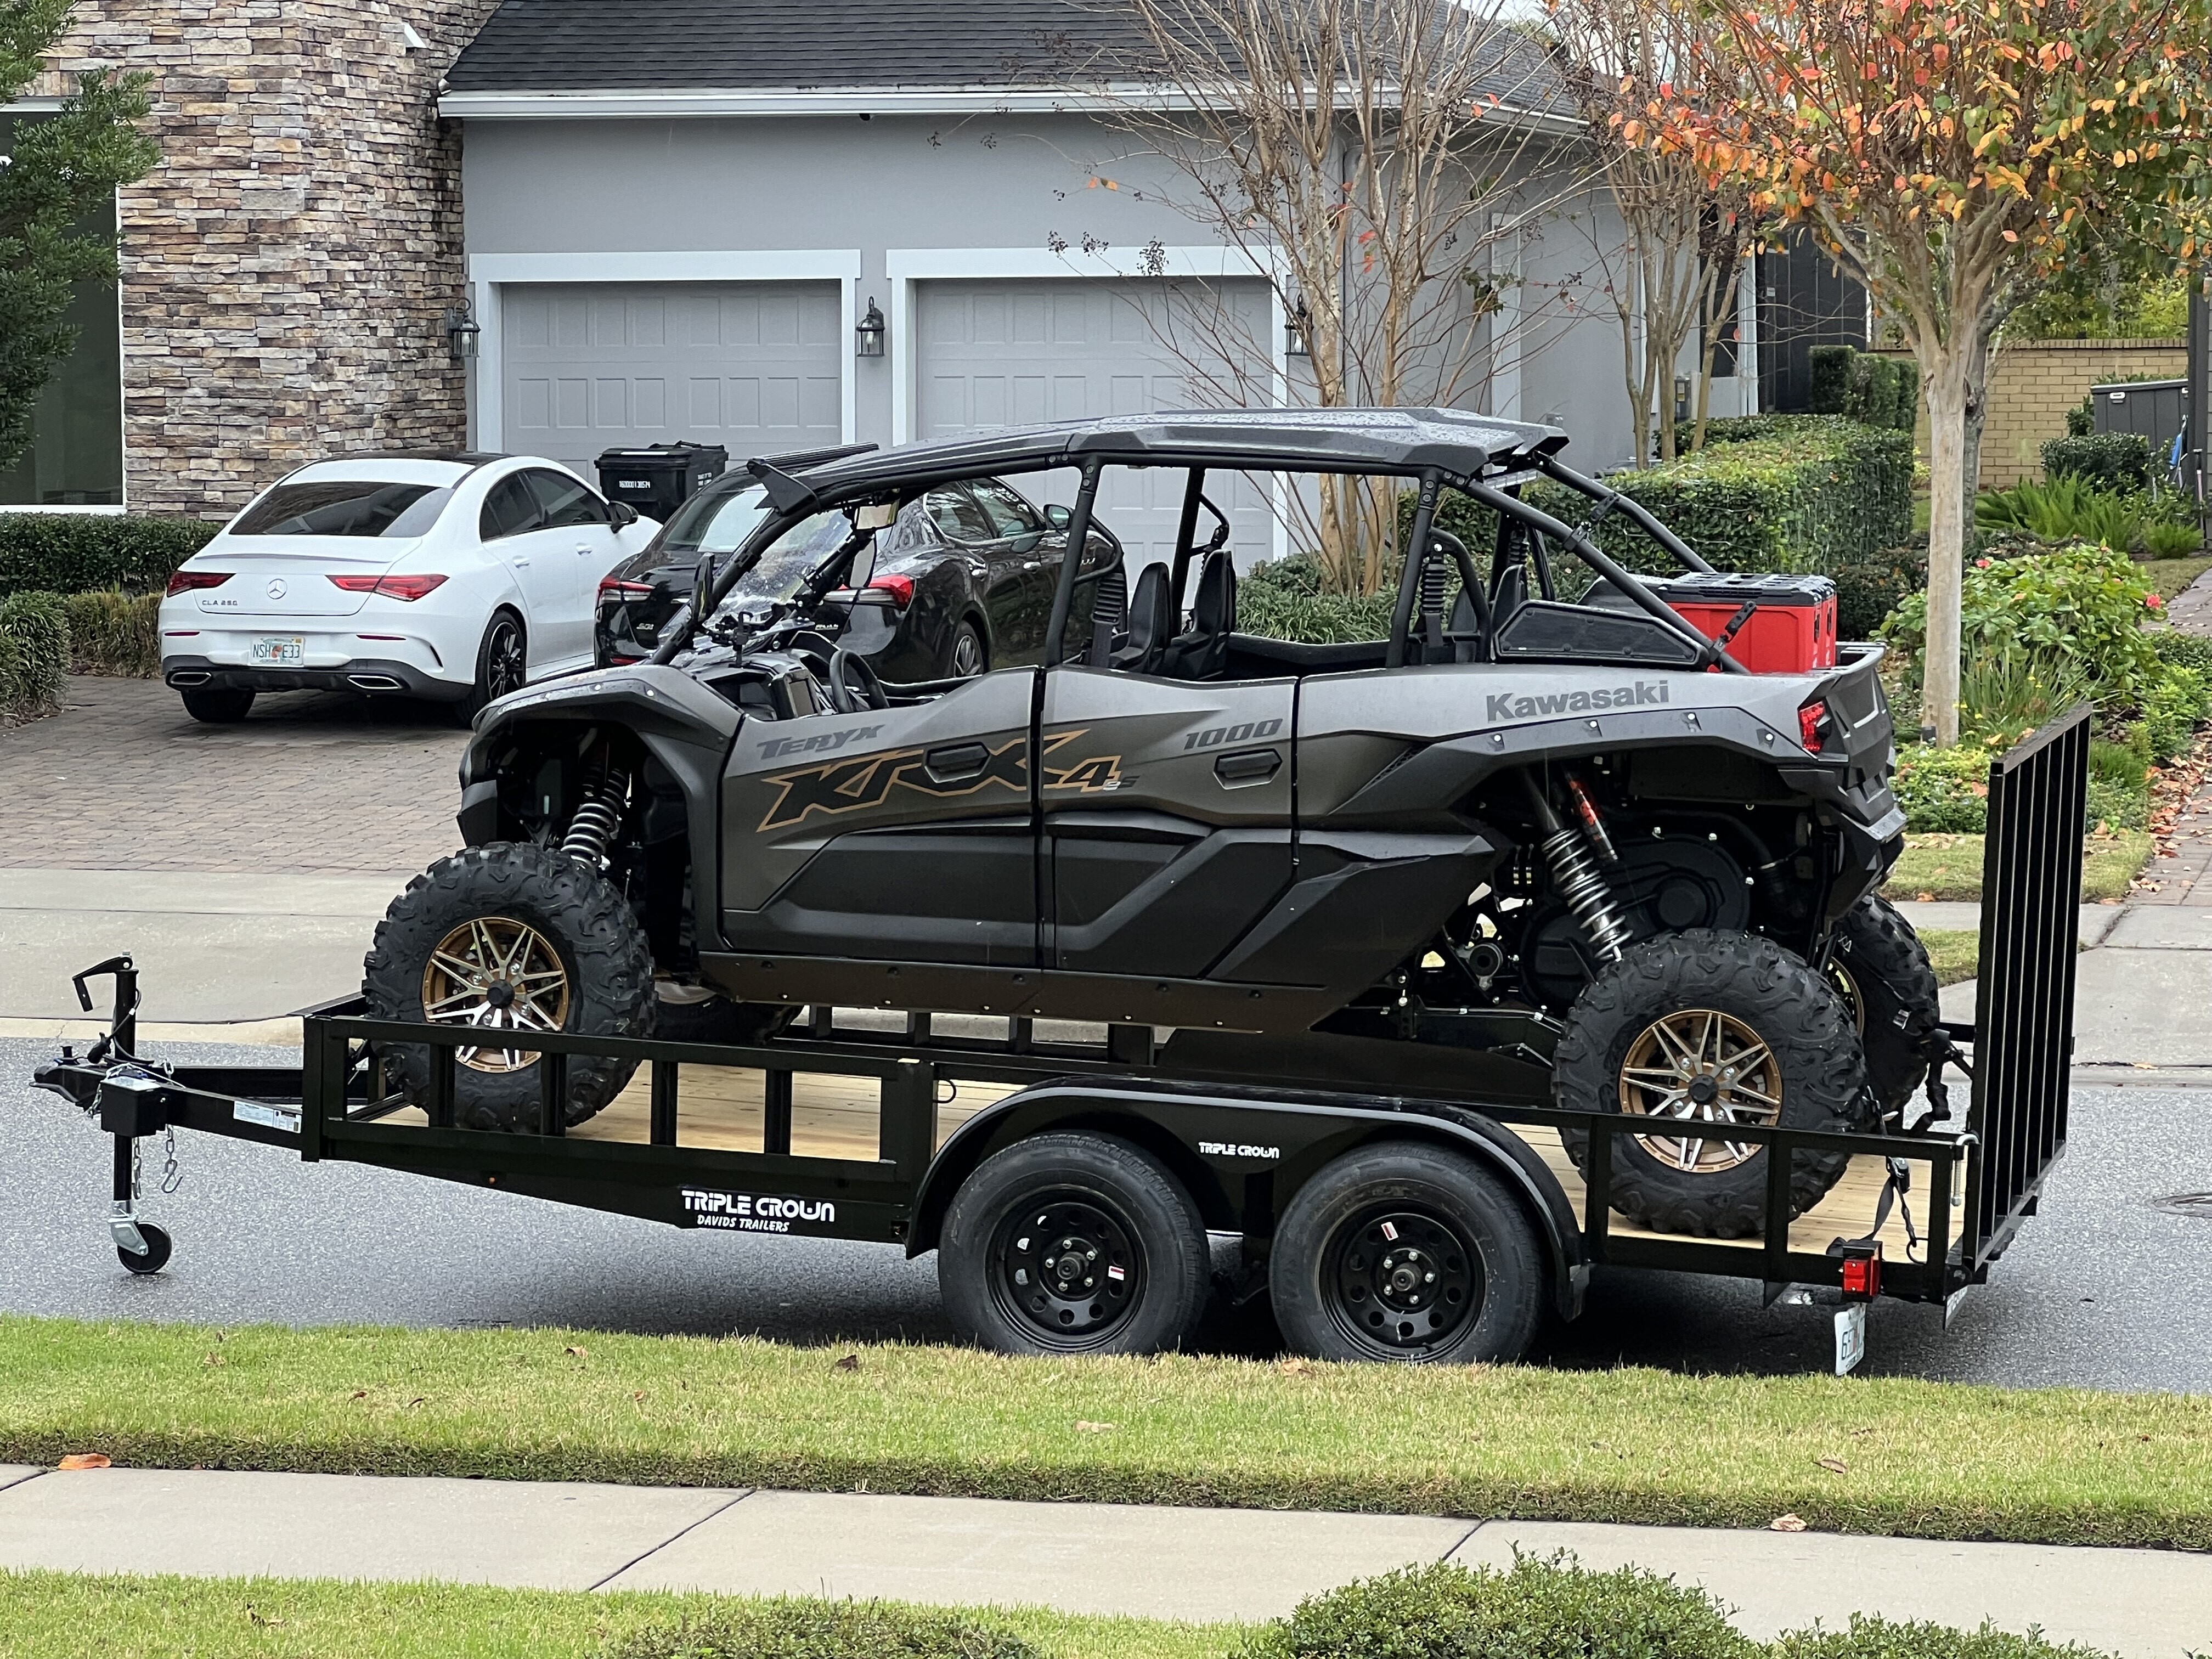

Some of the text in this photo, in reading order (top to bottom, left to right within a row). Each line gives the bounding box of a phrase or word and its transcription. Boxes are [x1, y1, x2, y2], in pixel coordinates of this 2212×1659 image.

[253, 644, 300, 658] NSH E33
[1486, 680, 1669, 723] Kawasaki
[757, 724, 885, 760] TERYX
[1184, 718, 1283, 750] 1000
[1198, 1142, 1279, 1159] TRIPLE CROWN
[681, 1190, 835, 1222] TRIPLE CROWN
[697, 1215, 790, 1233] DAVIDS TRAILERS
